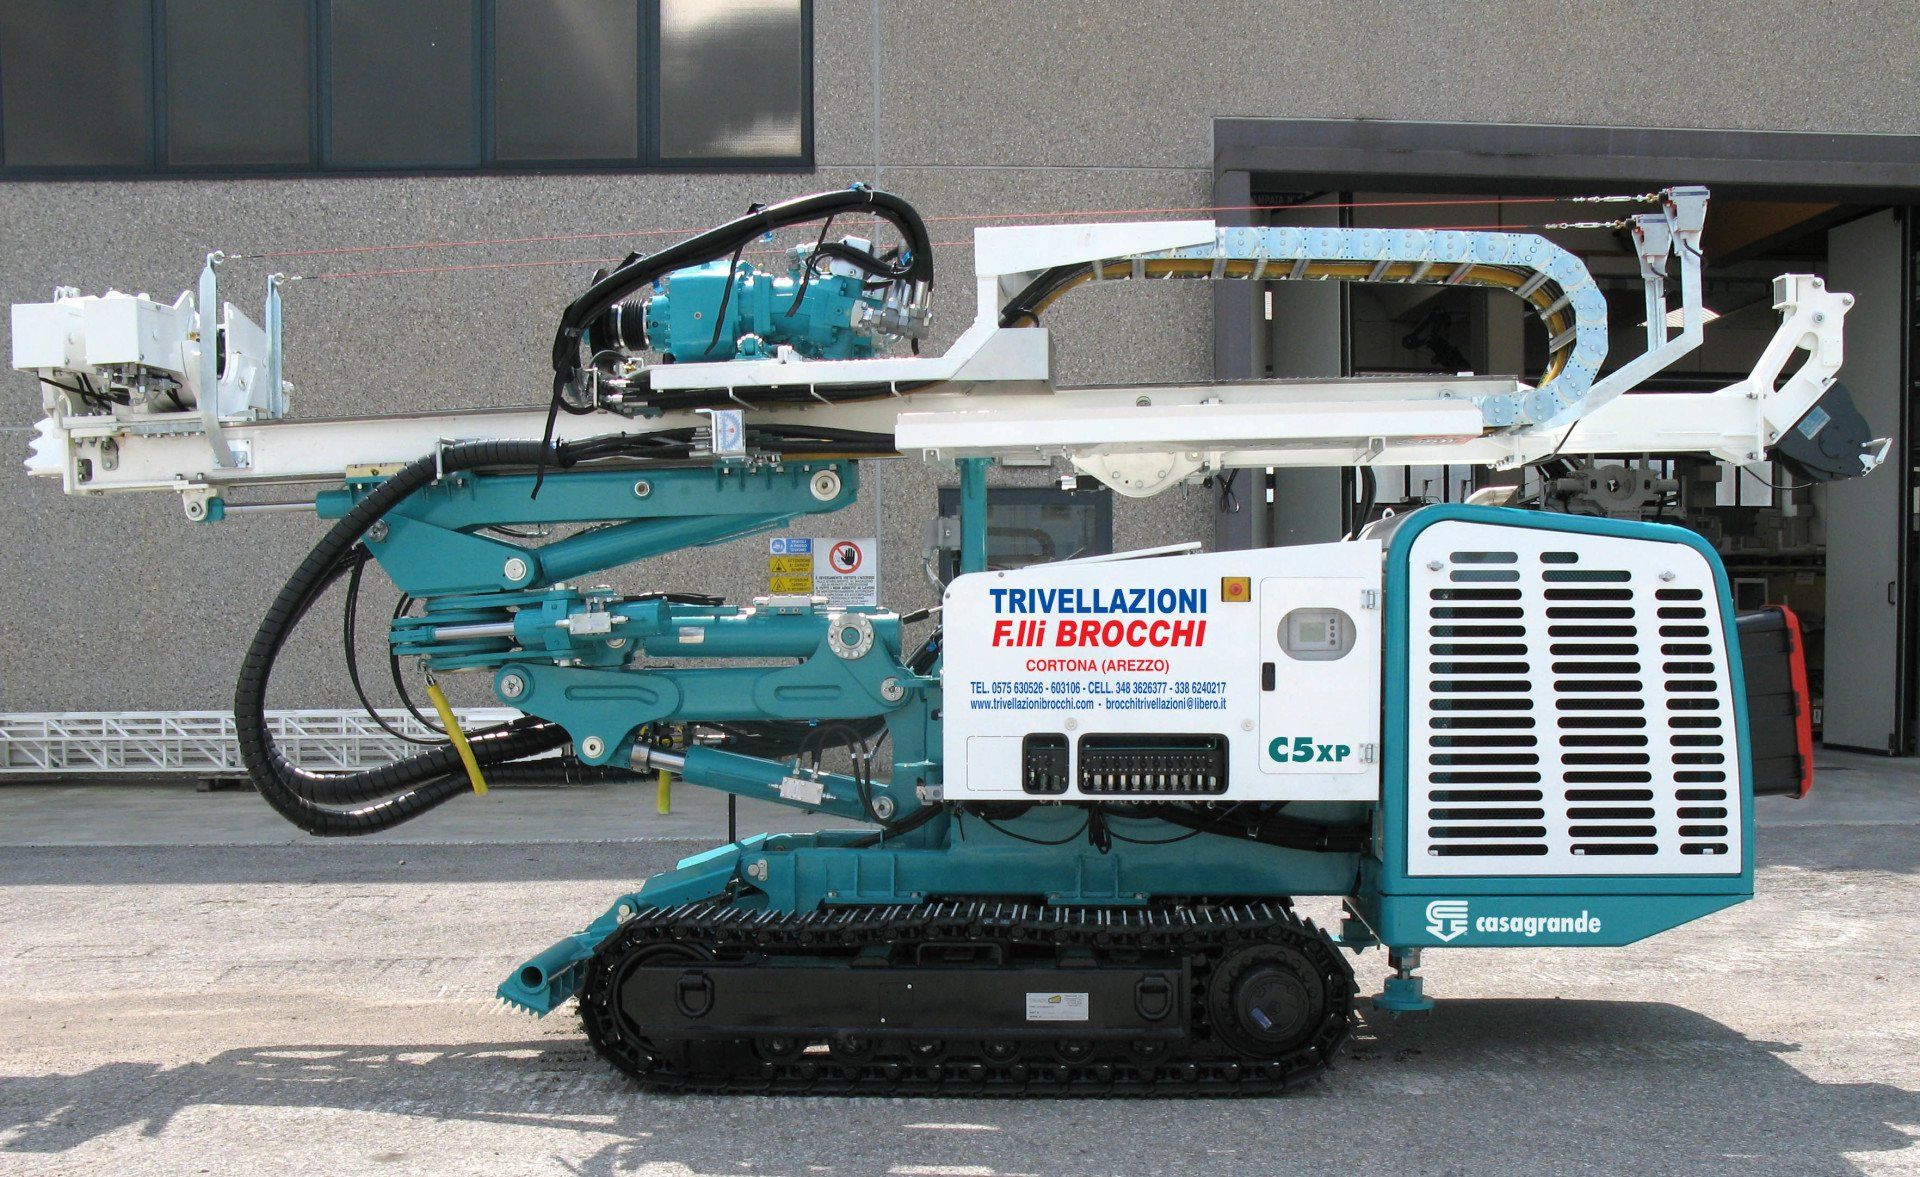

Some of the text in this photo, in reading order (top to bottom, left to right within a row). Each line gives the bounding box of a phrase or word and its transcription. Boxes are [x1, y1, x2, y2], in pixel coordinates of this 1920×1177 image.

[989, 588, 1207, 614] TRIVELLAZIONI
[992, 620, 1206, 647] F.lli BROCCHI
[1026, 659, 1169, 674] CORTONA (AREZZO)
[970, 682, 989, 694] TEL.
[992, 682, 1011, 694] 0575
[1014, 682, 1043, 694] 630526
[1051, 682, 1080, 694] 603106
[1088, 682, 1113, 694] CELL.
[1116, 682, 1130, 694] 348
[1133, 682, 1167, 694] 3626377
[1175, 682, 1190, 694] 338
[1192, 682, 1226, 694] 6240217
[970, 698, 1094, 710] www.trivellazionibrocchi.com
[1106, 697, 1226, 710] brocchitrivellazioni@libero.it
[1476, 911, 1601, 937] casagrande
